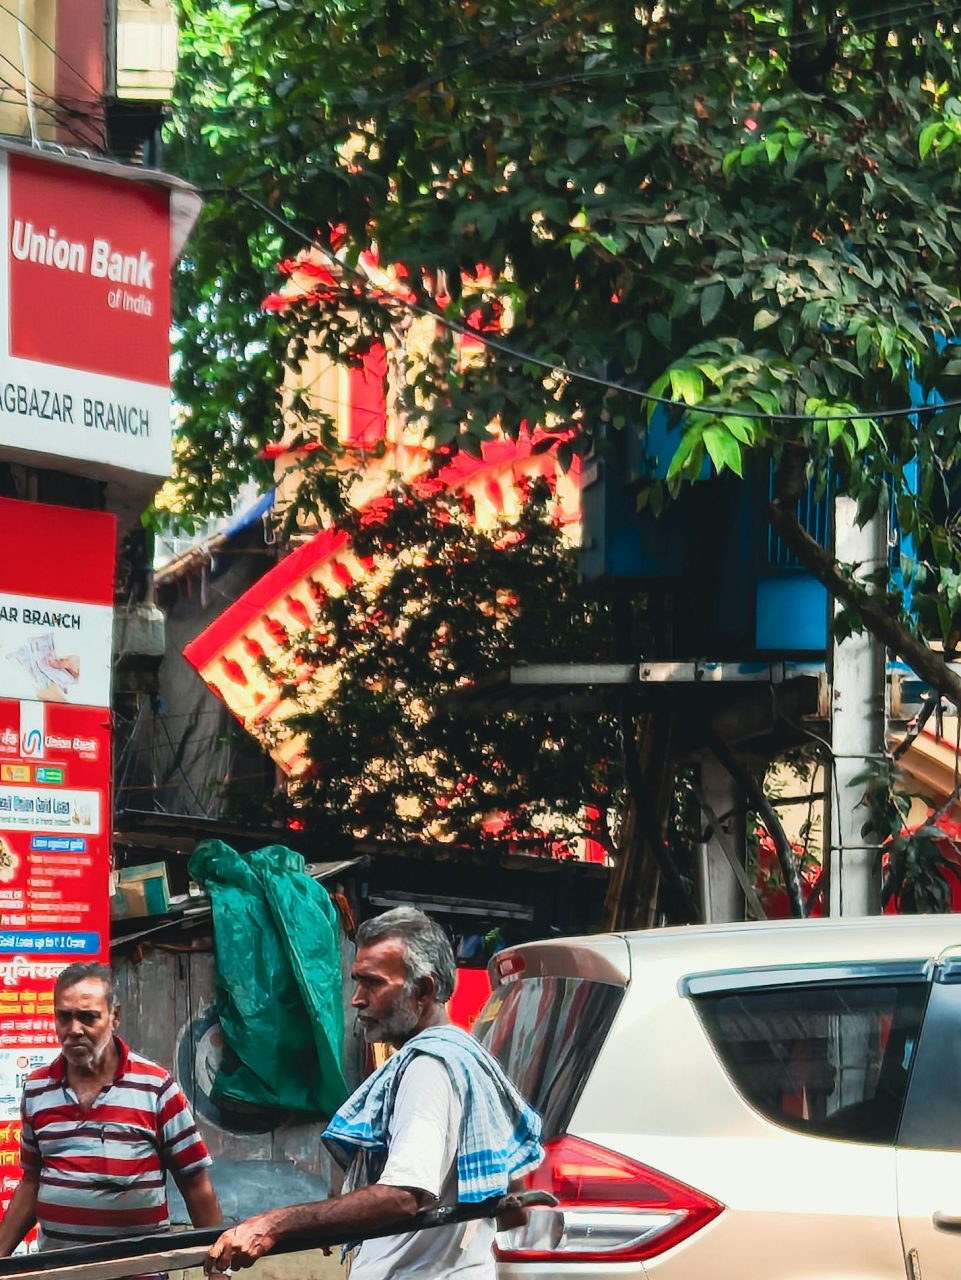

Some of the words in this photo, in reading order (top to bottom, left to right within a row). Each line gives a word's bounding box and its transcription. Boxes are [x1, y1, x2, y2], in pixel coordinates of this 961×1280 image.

[12, 220, 86, 273] Union
[90, 238, 154, 289] Bank
[108, 290, 122, 309] of
[122, 291, 152, 316] India
[83, 398, 149, 437] BRANCH
[23, 609, 81, 630] BRANCH
